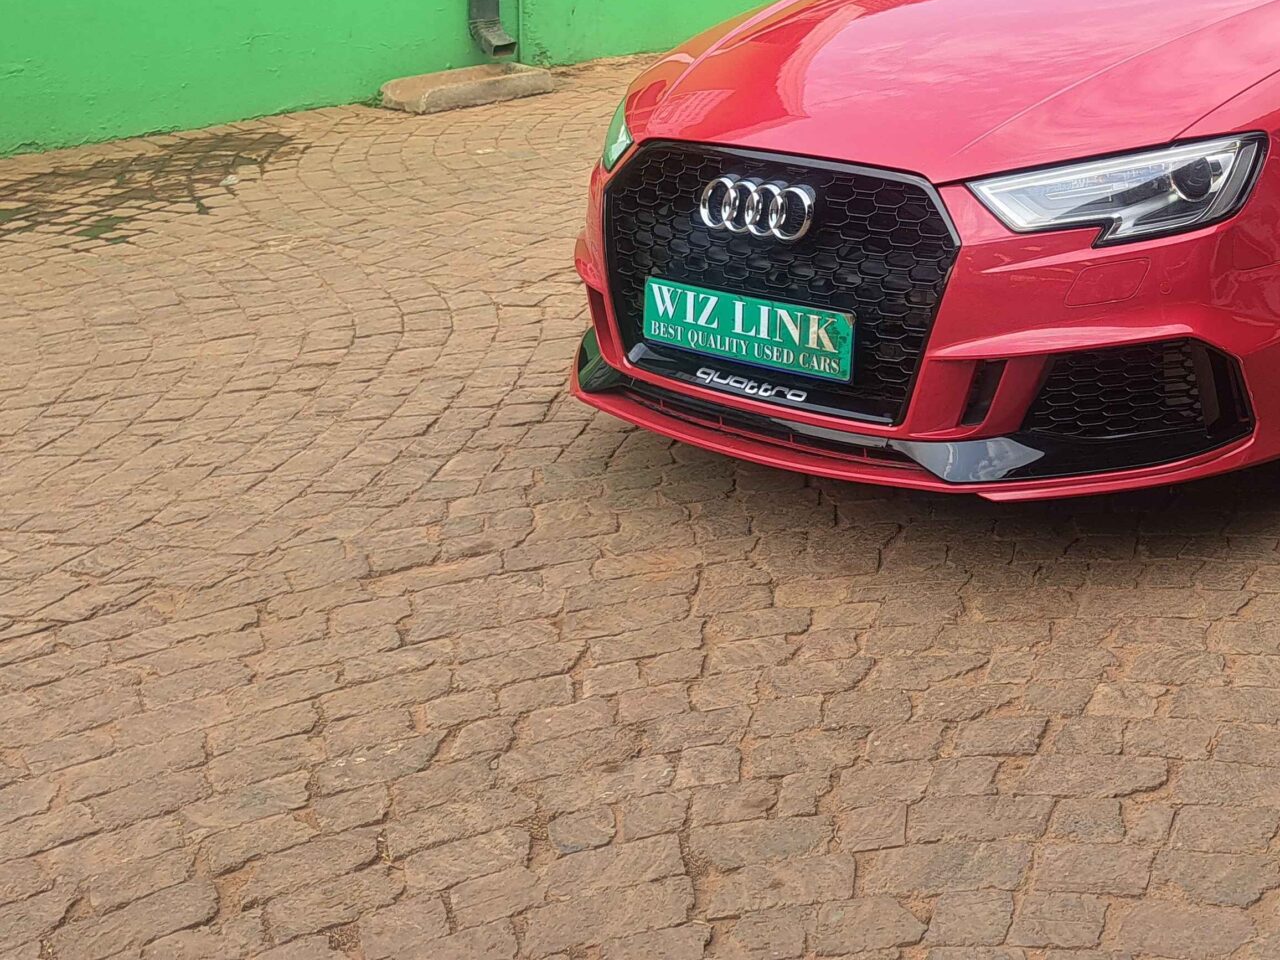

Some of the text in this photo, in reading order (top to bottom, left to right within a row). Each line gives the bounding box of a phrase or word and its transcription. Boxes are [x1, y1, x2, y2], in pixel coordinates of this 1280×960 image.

[650, 282, 839, 354] WIZ LINK
[650, 319, 841, 375] BEST QUALITY USED CARS
[696, 367, 808, 402] quattro
